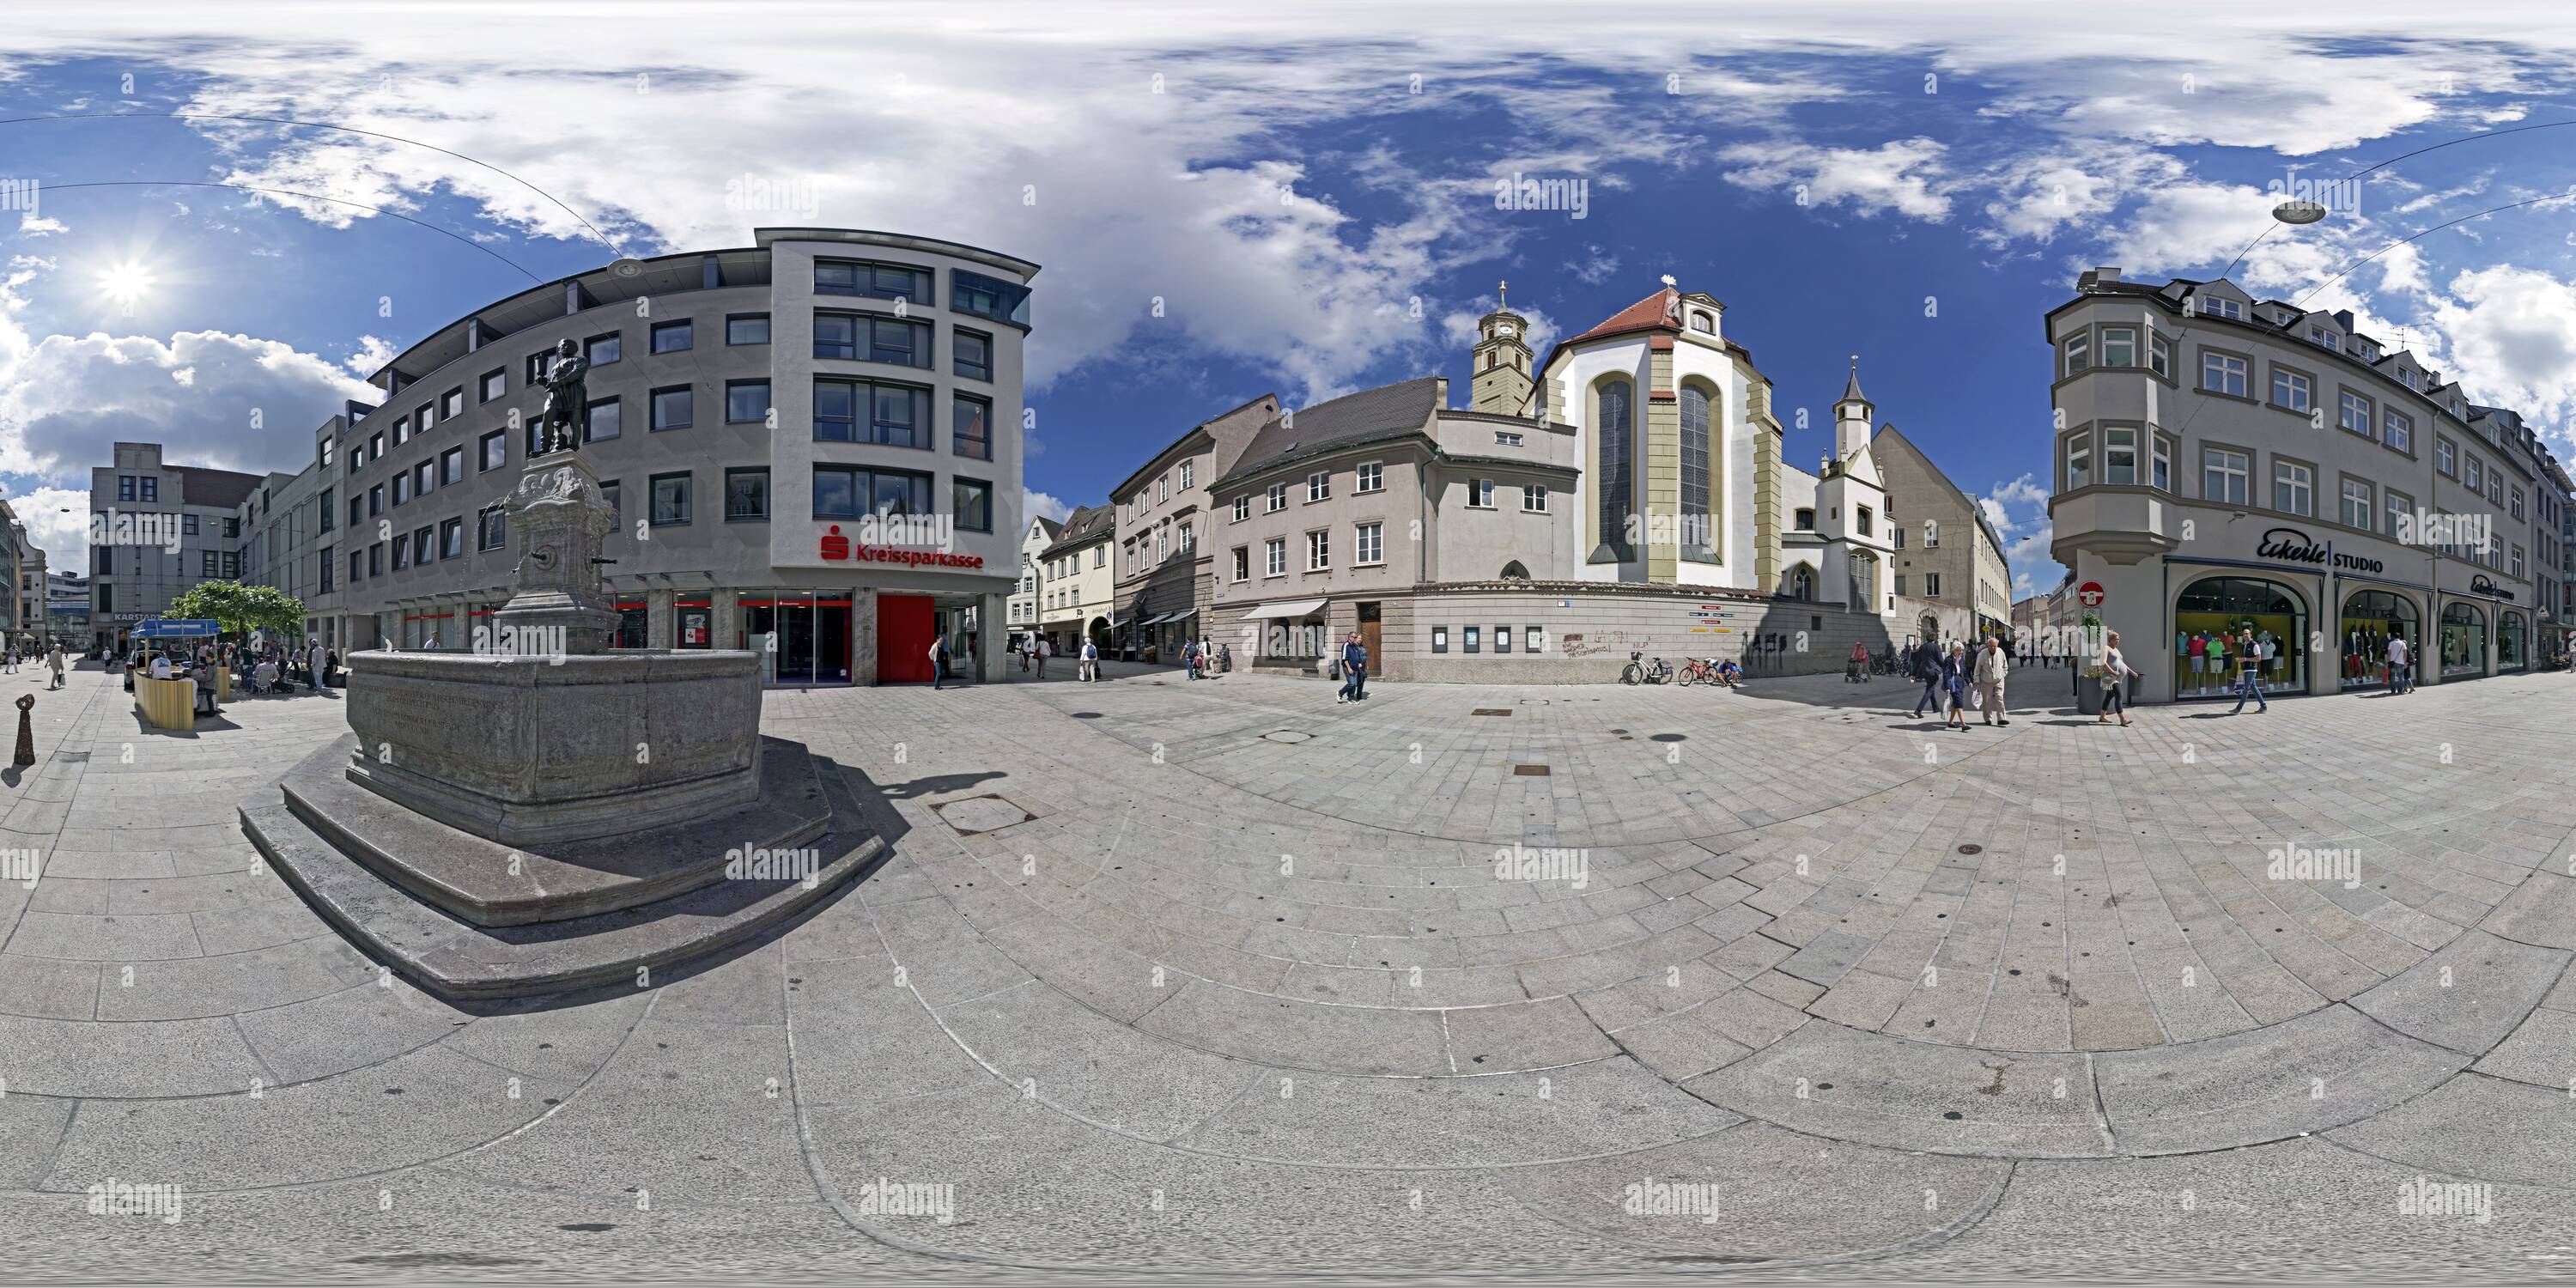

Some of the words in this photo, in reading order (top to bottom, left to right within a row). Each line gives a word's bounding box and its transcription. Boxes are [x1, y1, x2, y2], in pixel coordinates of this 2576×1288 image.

[857, 544, 984, 568] Kreissparkasse
[2257, 528, 2326, 563] Eckerle
[2334, 554, 2383, 574] STUDIO
